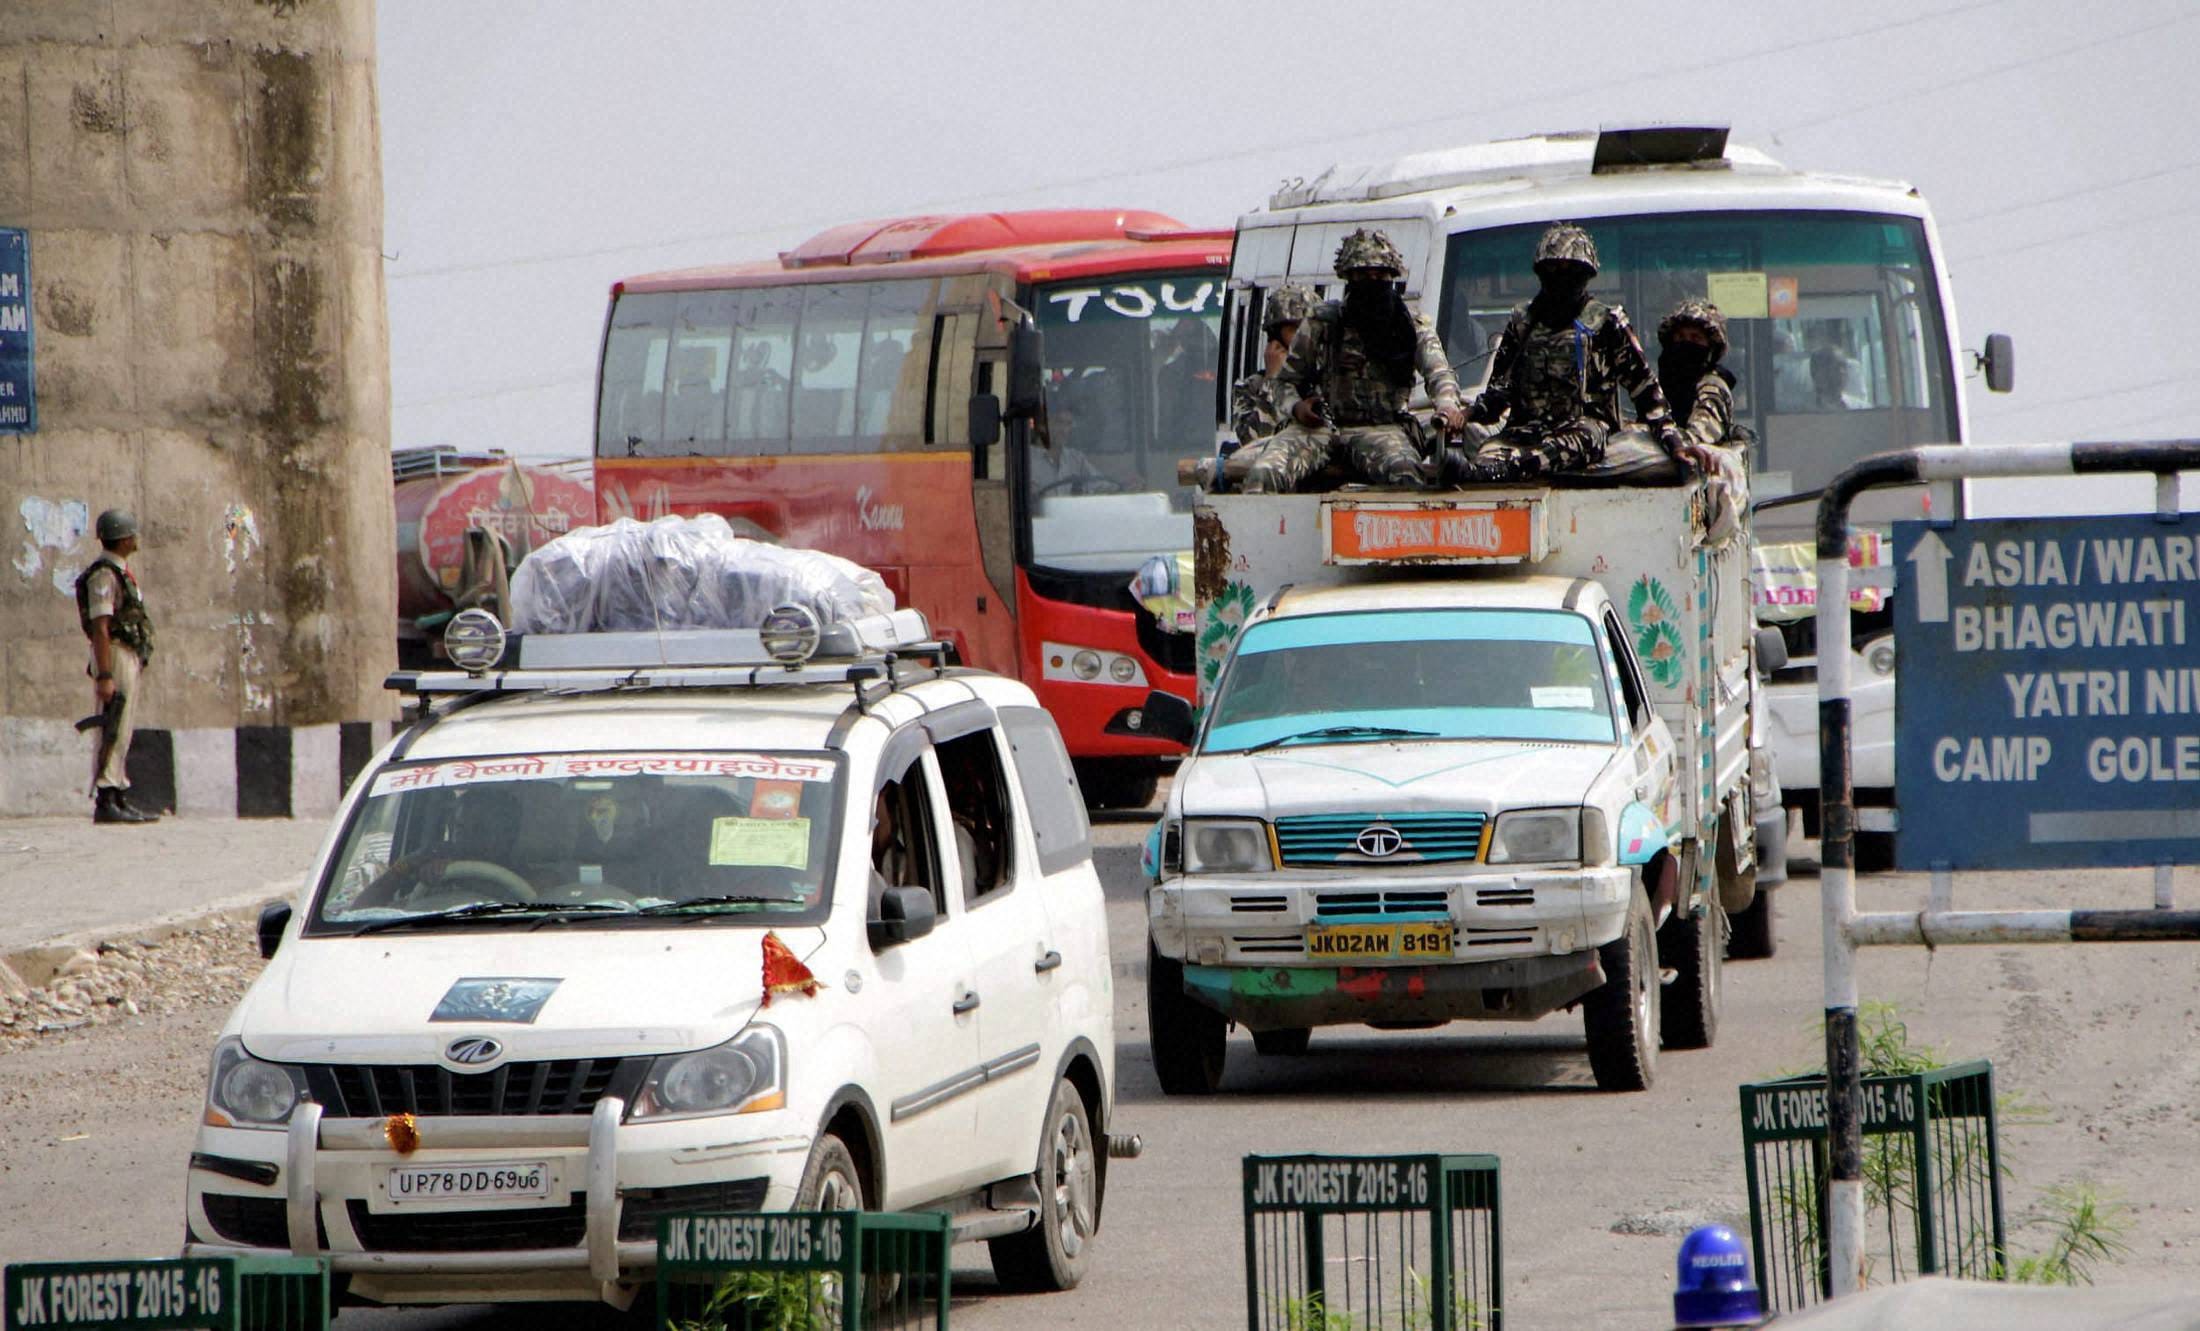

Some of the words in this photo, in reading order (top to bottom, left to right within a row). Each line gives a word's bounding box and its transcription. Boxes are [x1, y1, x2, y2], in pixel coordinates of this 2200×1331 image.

[0, 273, 19, 297] M
[1050, 281, 1226, 322] TOU
[1438, 513, 1501, 553] MAIL
[1955, 600, 2186, 651] BHAGWATI
[2004, 670, 2130, 718] YATRI
[2146, 669, 2200, 714] NI
[1933, 736, 2051, 782] CAMP
[2087, 736, 2200, 783] GOLE
[1403, 934, 1451, 952] 8191
[1753, 1092, 1777, 1131] JK
[1779, 1088, 1830, 1129] FORES
[1253, 1163, 1279, 1204] JK
[1282, 1163, 1352, 1204] FOREST
[666, 1218, 690, 1261] JK
[694, 1217, 765, 1261] FOREST
[17, 1277, 47, 1325] JK
[51, 1272, 131, 1323] FOREST
